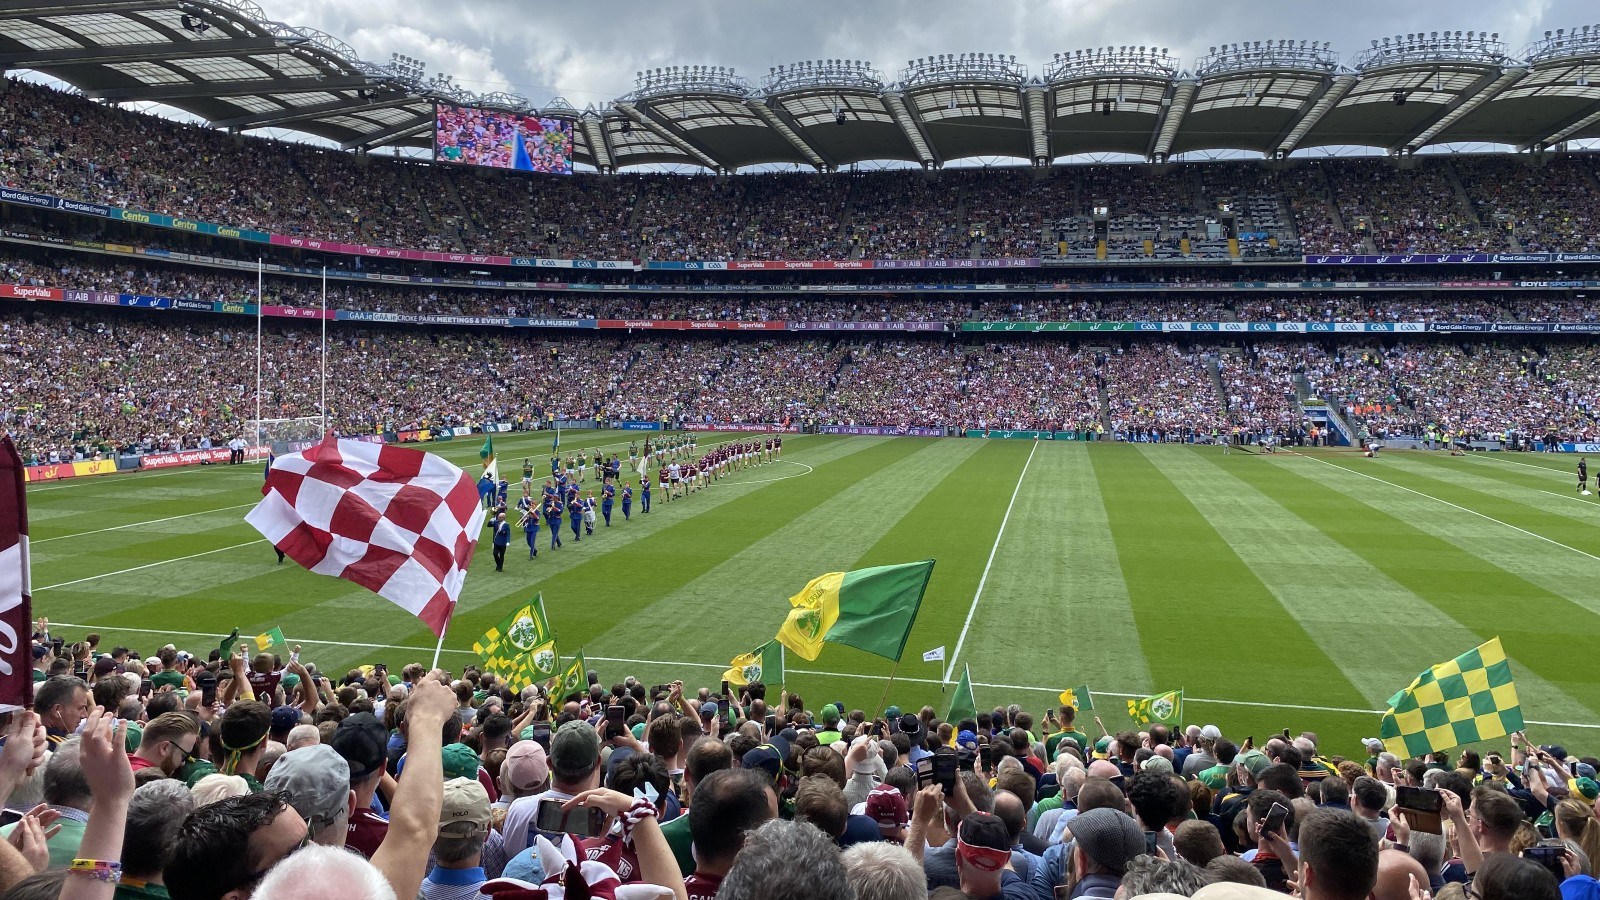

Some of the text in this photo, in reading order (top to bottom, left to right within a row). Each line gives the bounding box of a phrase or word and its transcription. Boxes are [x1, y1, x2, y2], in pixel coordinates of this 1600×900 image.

[2, 191, 16, 200] Bord
[30, 196, 50, 206] Energy
[65, 202, 78, 210] Bord
[90, 206, 108, 216] Energy
[122, 210, 150, 223] Centra
[172, 218, 198, 231] Centra
[217, 226, 240, 238] Centra
[290, 238, 303, 248] very
[308, 240, 322, 249] very
[366, 247, 380, 256] very
[386, 249, 401, 258] very
[450, 254, 465, 262] very
[471, 256, 486, 264] very
[516, 258, 532, 266] GAA
[1526, 255, 1546, 263] Energy
[541, 259, 557, 267] GAA
[13, 286, 50, 298] SuperValu
[75, 292, 88, 301] AIB
[103, 294, 116, 303] AIB
[198, 302, 212, 310] Energy
[222, 304, 244, 313] Centra
[284, 308, 298, 318] very
[302, 309, 316, 318] very
[350, 311, 372, 320] GAA.ie
[373, 312, 398, 322] GAA.ie
[418, 314, 436, 322] PARK
[437, 316, 474, 324] MEETINGS
[482, 318, 510, 326] EVENTS
[691, 321, 718, 329] SuperValu
[738, 322, 766, 330] SuperValu
[1141, 322, 1158, 331] GAA
[1168, 322, 1184, 331] GAA
[1196, 322, 1213, 331] GAA
[1225, 322, 1242, 331] GAA
[1254, 323, 1270, 331] GAA
[1282, 322, 1299, 331] GAA
[1312, 322, 1328, 331] GAA
[1341, 323, 1358, 331] GAA
[1371, 323, 1388, 331] GAA
[1400, 323, 1418, 331] GAA
[1464, 324, 1482, 332] Energy
[742, 424, 766, 432] SuperValu
[144, 455, 178, 467] SuperValu
[180, 452, 211, 462] SuperValu
